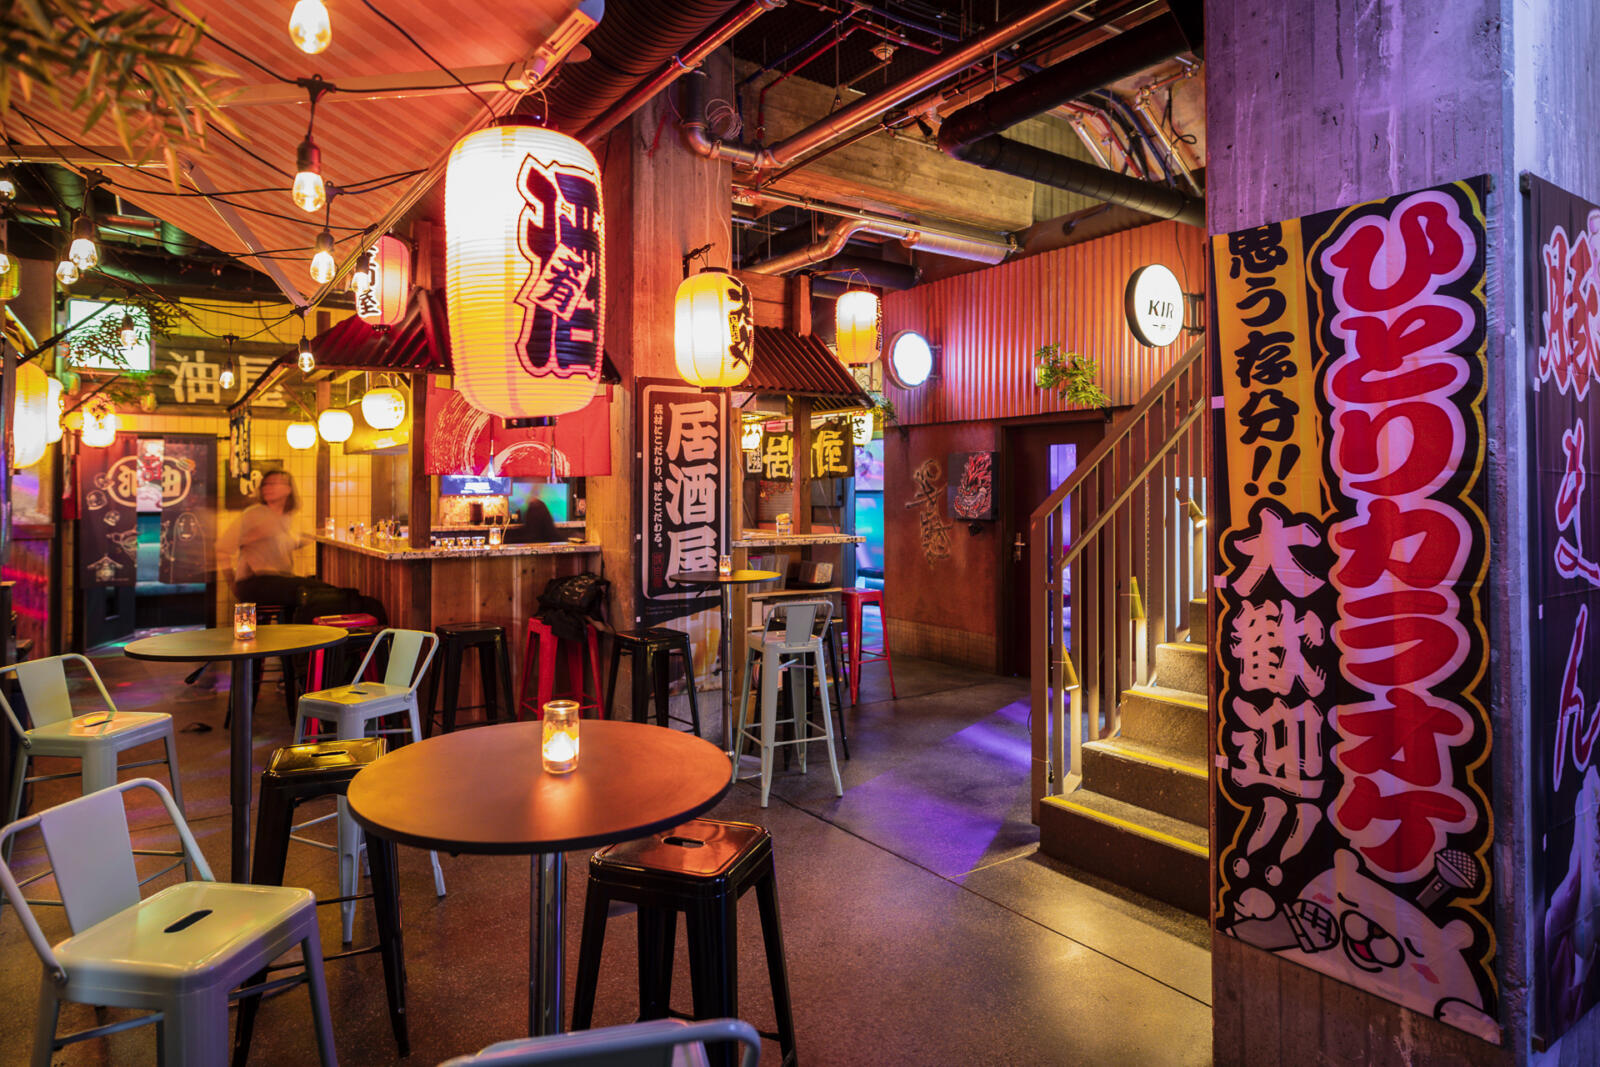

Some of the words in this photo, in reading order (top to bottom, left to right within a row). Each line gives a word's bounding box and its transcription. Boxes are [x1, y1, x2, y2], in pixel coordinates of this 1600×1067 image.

[665, 400, 718, 589] 居酒屋
[1324, 195, 1473, 878] ひとりカラオケ
